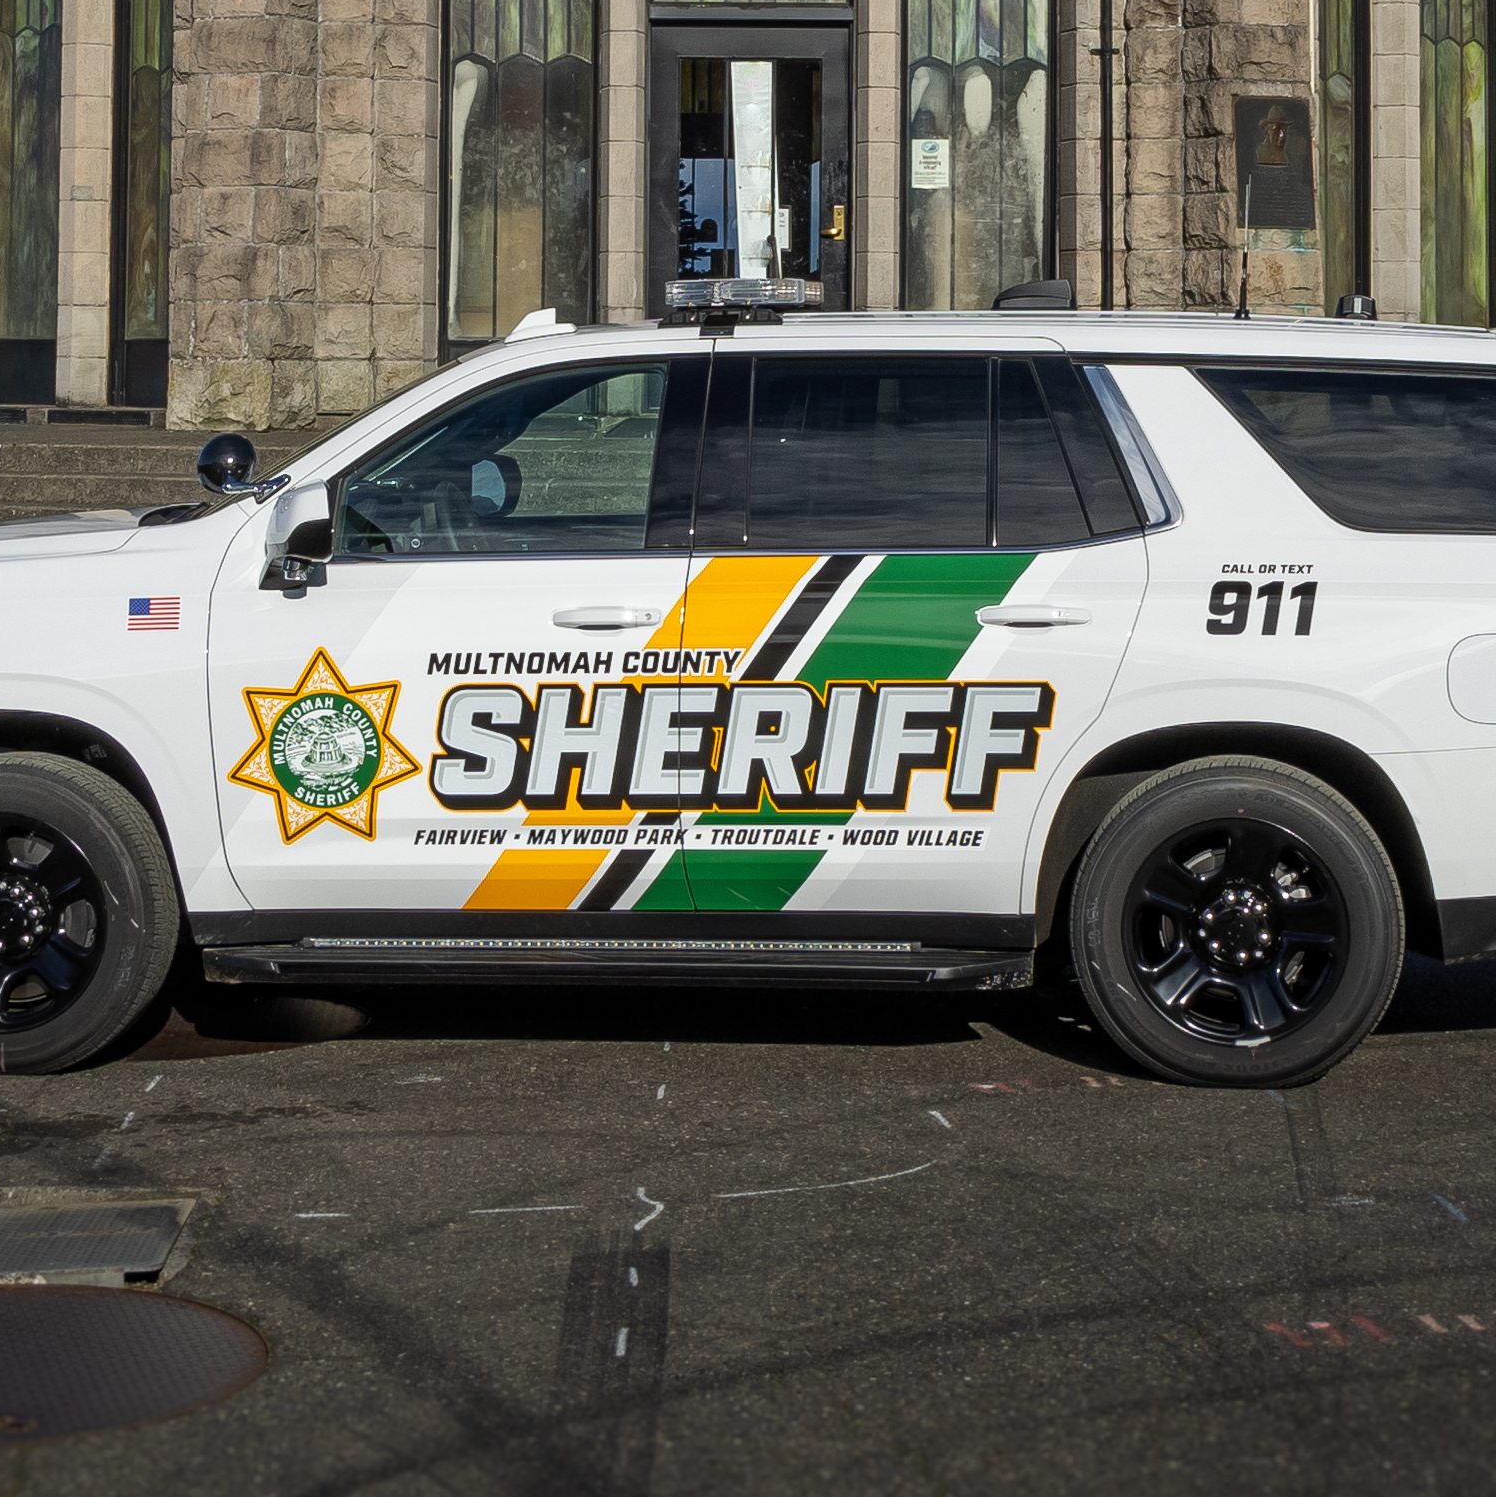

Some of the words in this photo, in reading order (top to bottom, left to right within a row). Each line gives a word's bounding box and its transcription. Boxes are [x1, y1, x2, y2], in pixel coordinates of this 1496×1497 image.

[1221, 564, 1254, 574] CALL
[1258, 564, 1277, 574] OR
[1280, 564, 1314, 574] TEXT
[1206, 580, 1319, 636] 911
[427, 652, 613, 675] MULTNOMAH
[622, 651, 742, 674] COUNTY
[272, 697, 335, 766] MULTNOMAH
[342, 703, 378, 758] COUNTY
[430, 681, 1056, 812] SHERIFF
[294, 782, 361, 807] SHERIFF
[414, 829, 507, 845] FAIRVIEW
[527, 828, 629, 845] MAYWOOD
[634, 828, 689, 845] PARK
[710, 829, 821, 846] TROUTDALE
[842, 829, 900, 846] WOOD
[906, 829, 985, 847] VILLAGE
